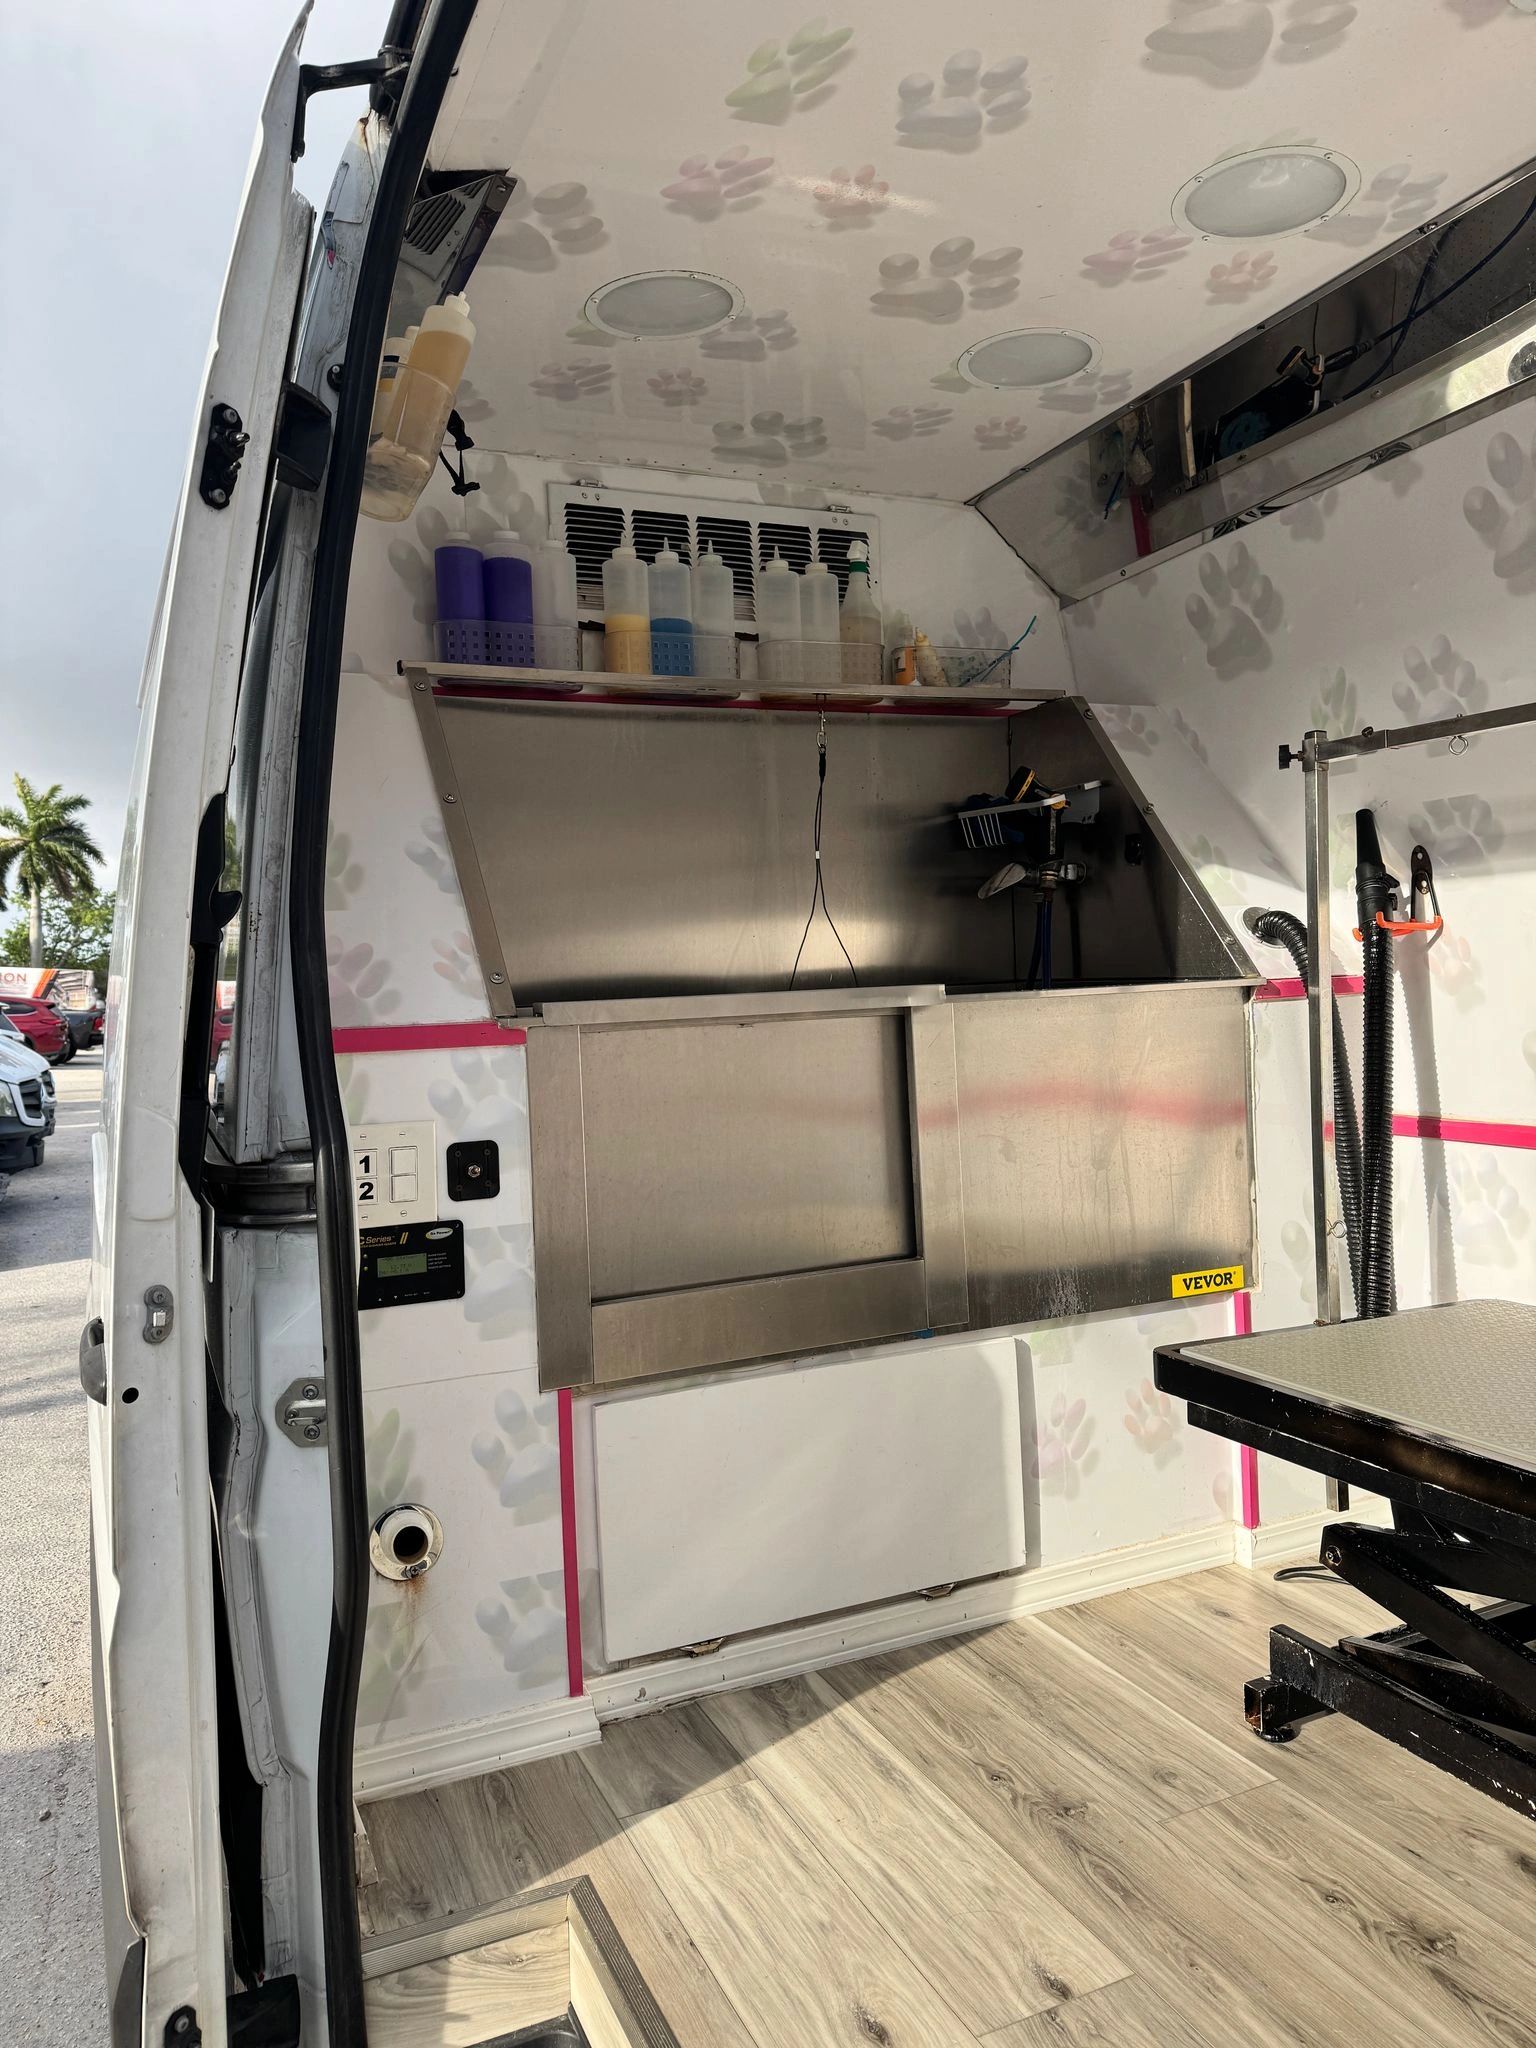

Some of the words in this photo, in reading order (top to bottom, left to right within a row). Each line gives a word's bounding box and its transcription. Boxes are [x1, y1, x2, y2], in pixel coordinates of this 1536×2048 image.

[359, 1155, 370, 1174] 1
[359, 1181, 374, 1201] 2
[366, 1235, 392, 1244] Series
[1183, 1272, 1233, 1291] VEVOR
